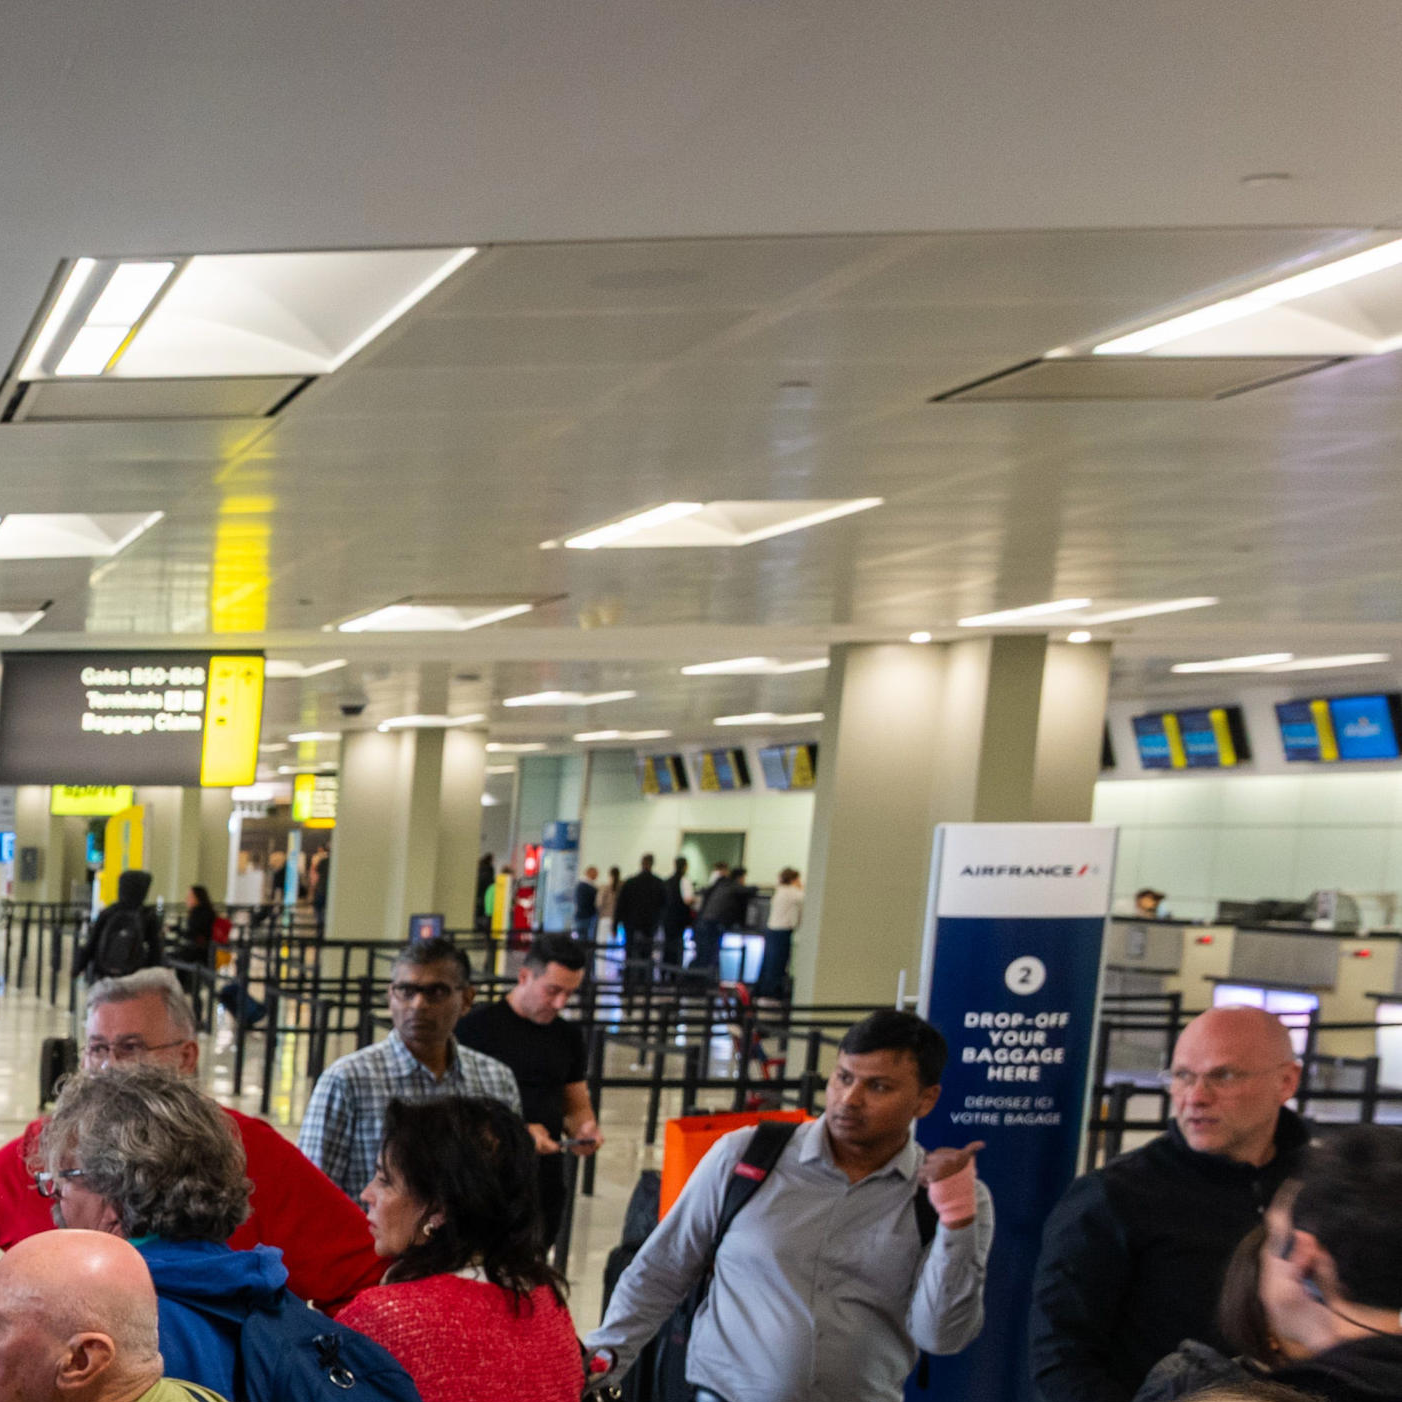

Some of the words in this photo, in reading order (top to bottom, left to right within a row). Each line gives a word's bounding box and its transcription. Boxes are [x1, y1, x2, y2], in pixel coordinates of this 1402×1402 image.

[960, 865, 1074, 877] AIRFRANCE
[1018, 966, 1032, 984] 2
[964, 1012, 1070, 1029] DROP-OFF
[988, 1030, 1047, 1046] YOUR
[962, 1047, 1065, 1064] BAGGAGE
[987, 1065, 1041, 1081] HERE
[950, 1111, 1000, 1125] VOTRE
